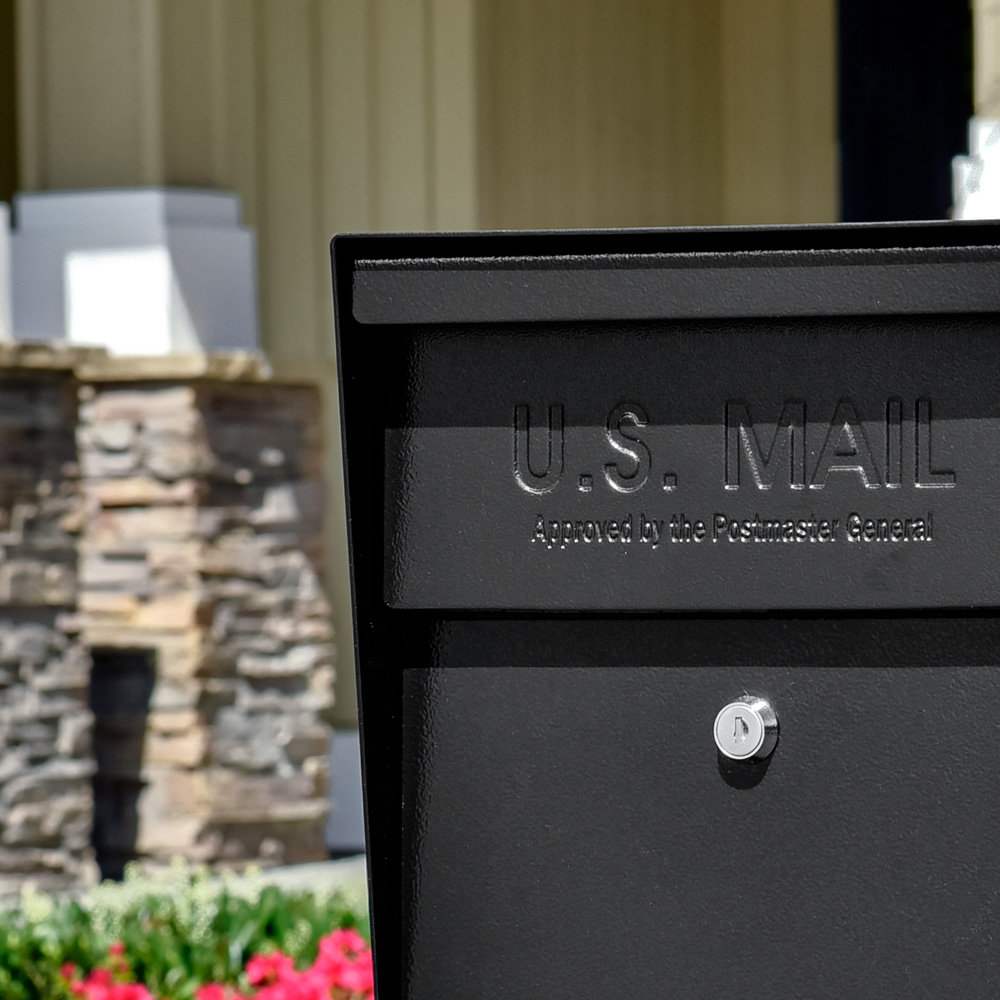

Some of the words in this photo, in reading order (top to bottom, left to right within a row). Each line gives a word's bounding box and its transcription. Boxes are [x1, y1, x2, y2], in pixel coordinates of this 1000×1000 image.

[513, 402, 677, 494] U.S.
[724, 397, 956, 489] MAIL
[531, 514, 633, 549] Approved
[640, 514, 665, 549] by
[670, 513, 706, 543] the
[713, 513, 838, 543] Postmaster
[847, 512, 933, 542] General
